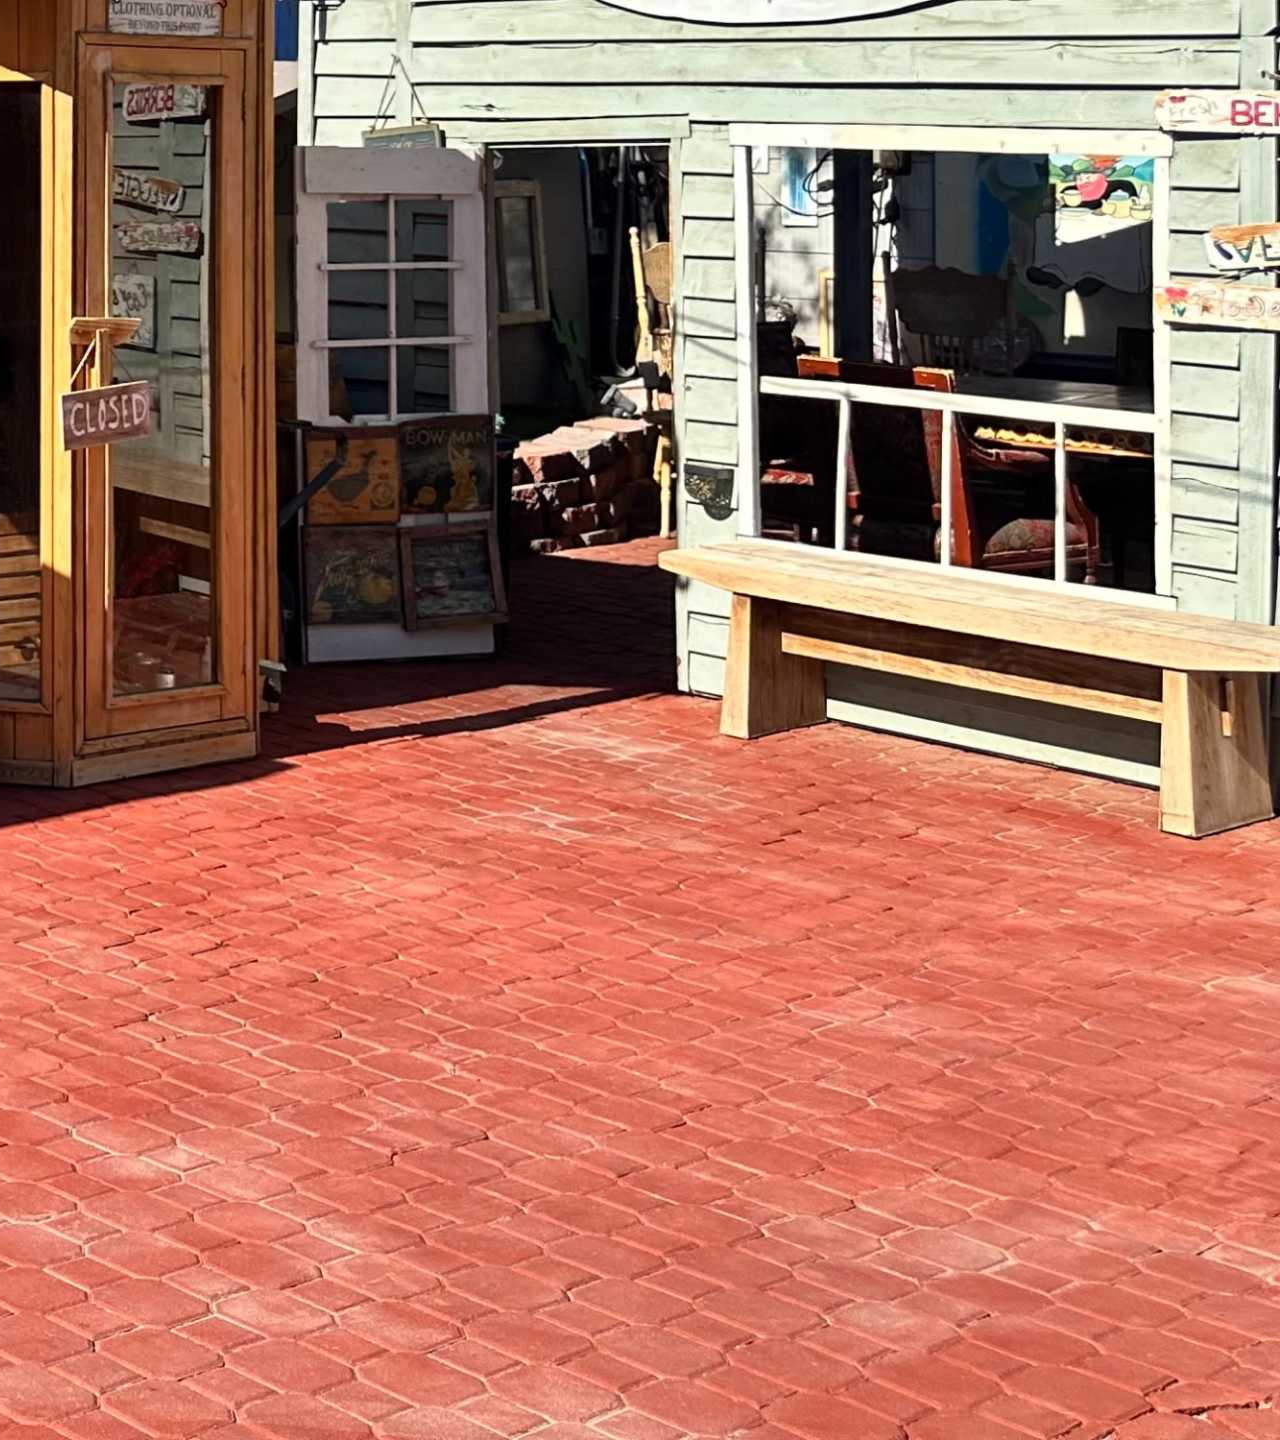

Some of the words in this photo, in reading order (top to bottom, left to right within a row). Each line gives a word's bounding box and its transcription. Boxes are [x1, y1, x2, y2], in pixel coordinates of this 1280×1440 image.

[111, 0, 164, 16] CLOTHING
[165, 3, 217, 18] OPTIONAL
[1230, 99, 1280, 127] BE
[70, 392, 149, 436] CLOSED
